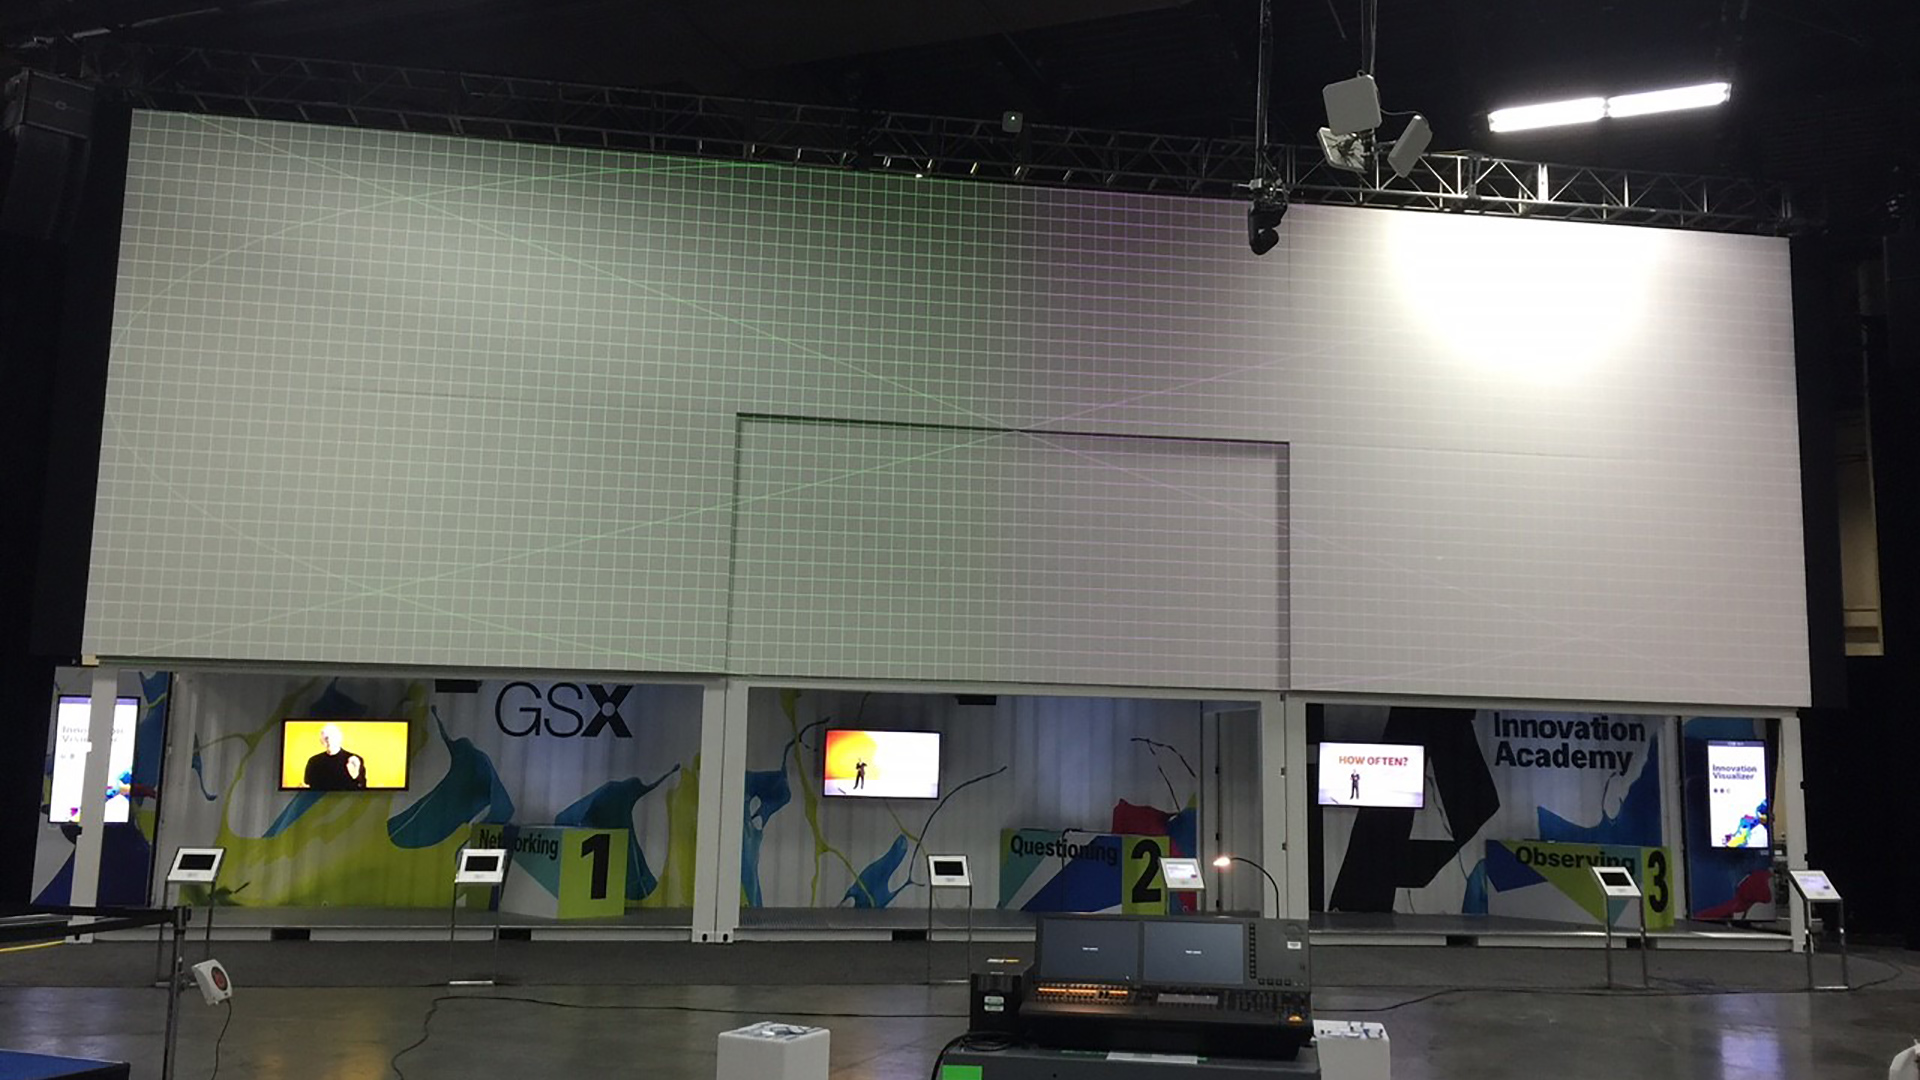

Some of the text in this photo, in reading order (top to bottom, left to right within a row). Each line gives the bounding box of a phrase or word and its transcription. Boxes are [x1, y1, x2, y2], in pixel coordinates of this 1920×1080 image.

[495, 681, 634, 738] GSX
[62, 726, 124, 735] Innoon
[1494, 712, 1645, 742] Innovation
[1339, 756, 1408, 766] HOW OFTEN?
[1495, 741, 1633, 776] Academy
[1712, 764, 1757, 773] Innovation
[1712, 772, 1755, 780] Visualizer
[479, 829, 559, 860] Netorking
[1010, 834, 1118, 866] Questioning
[581, 833, 610, 900] 1
[1131, 839, 1162, 904] 2
[1515, 846, 1636, 876] Observing
[1648, 851, 1669, 913] 3
